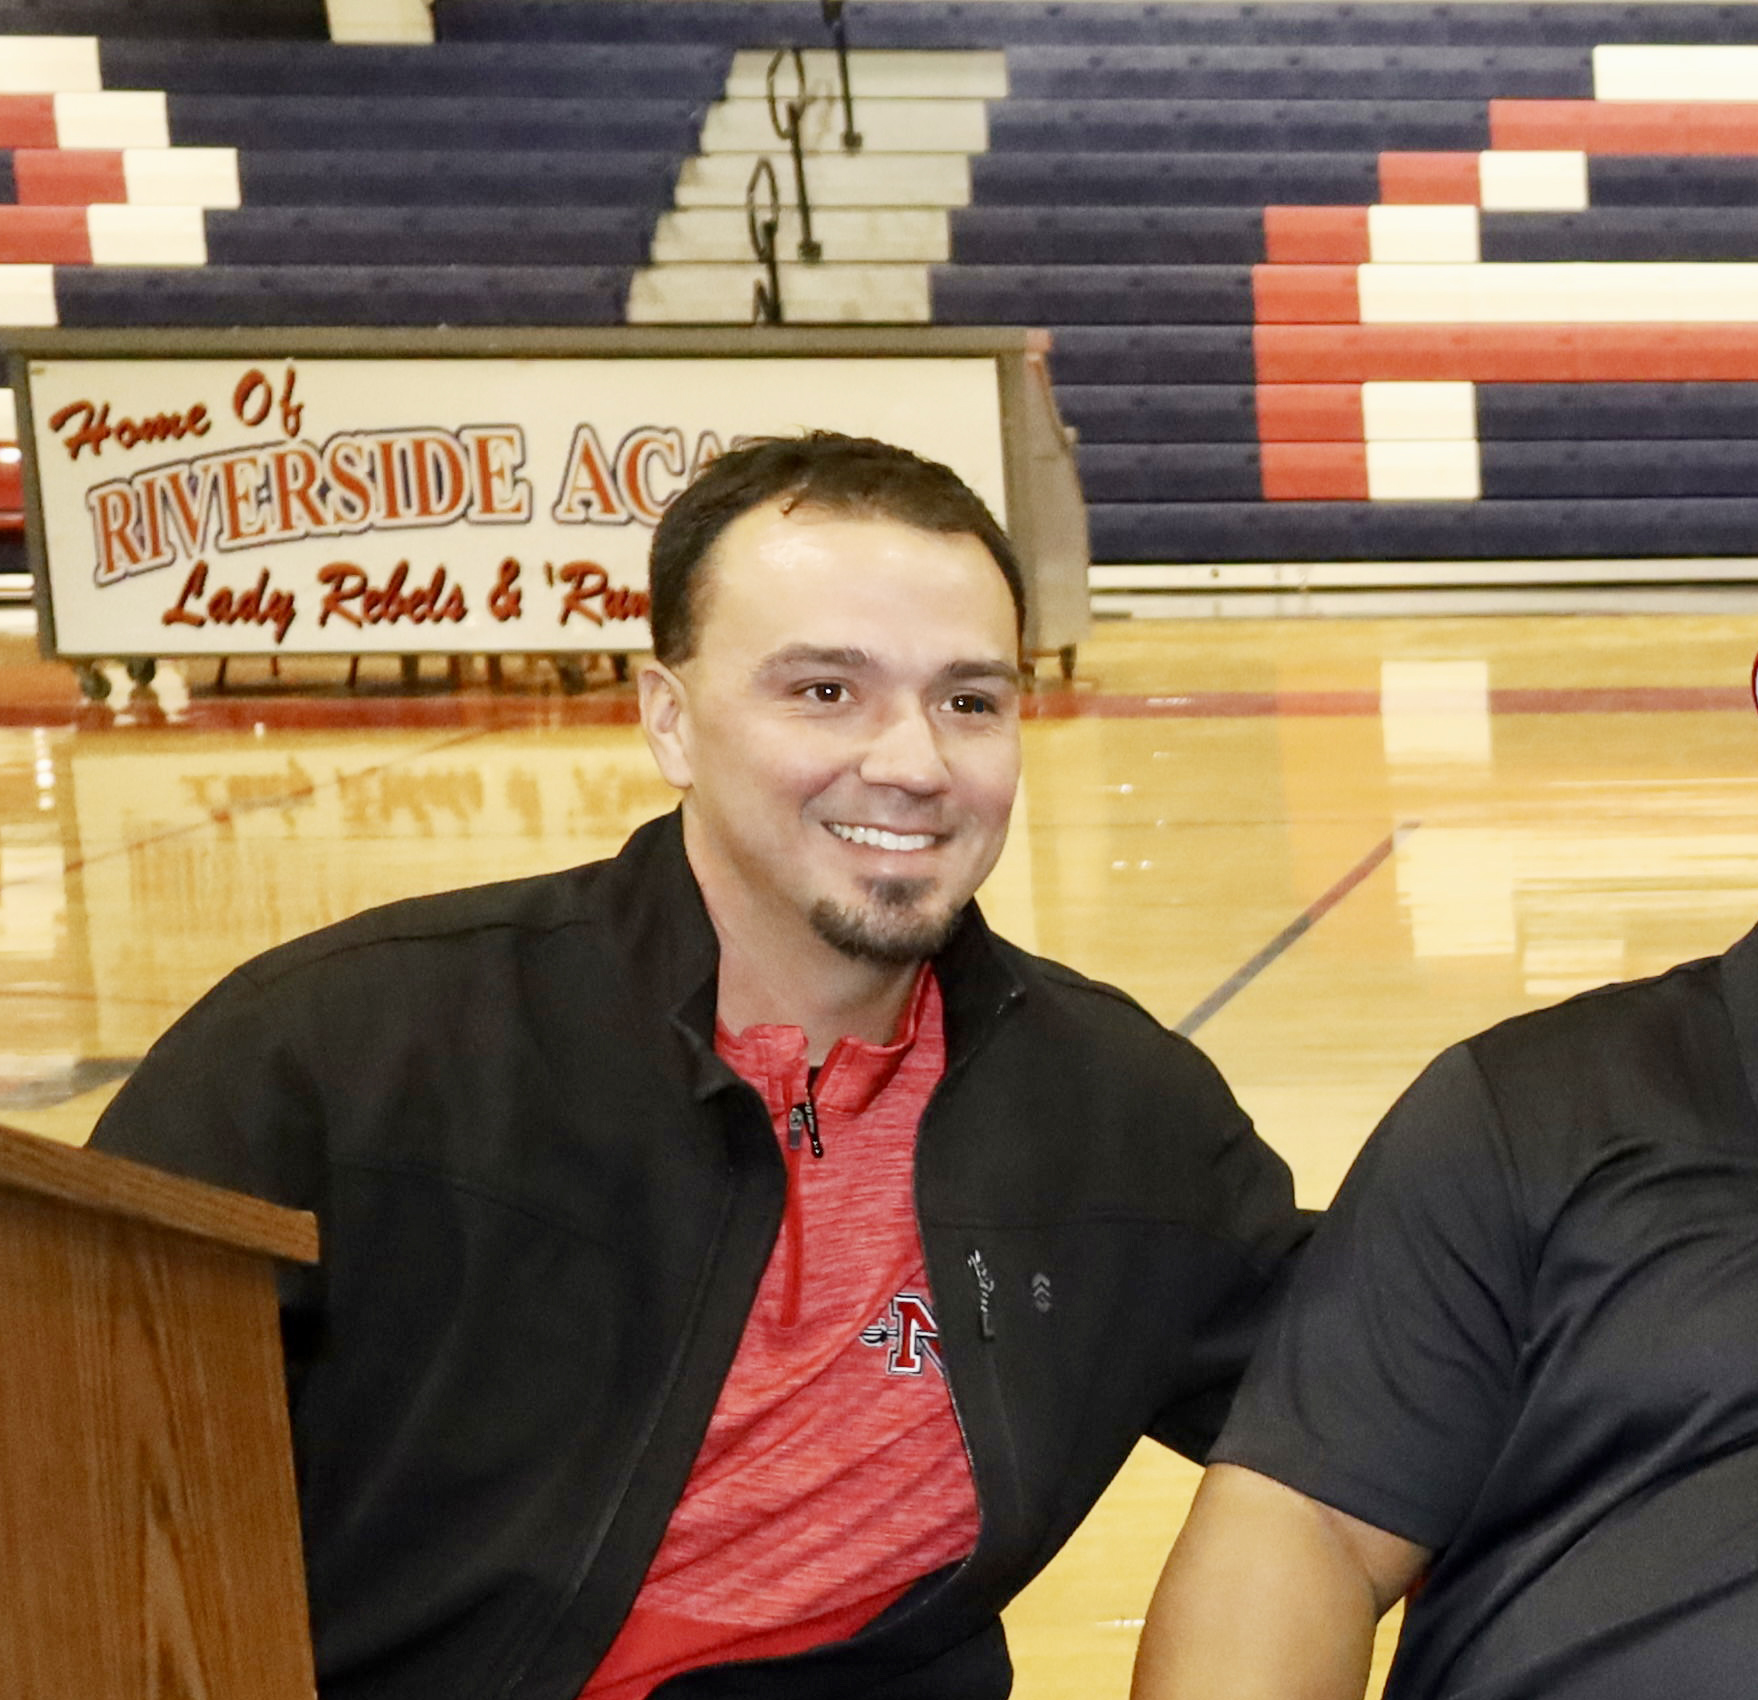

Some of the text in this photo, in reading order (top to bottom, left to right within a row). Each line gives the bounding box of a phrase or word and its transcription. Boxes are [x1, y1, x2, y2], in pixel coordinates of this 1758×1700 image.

[50, 367, 304, 461] Home Of
[87, 426, 532, 586] RIVERSIDE
[162, 561, 296, 644] Lady
[318, 559, 469, 629] Rebels
[488, 556, 522, 622] &
